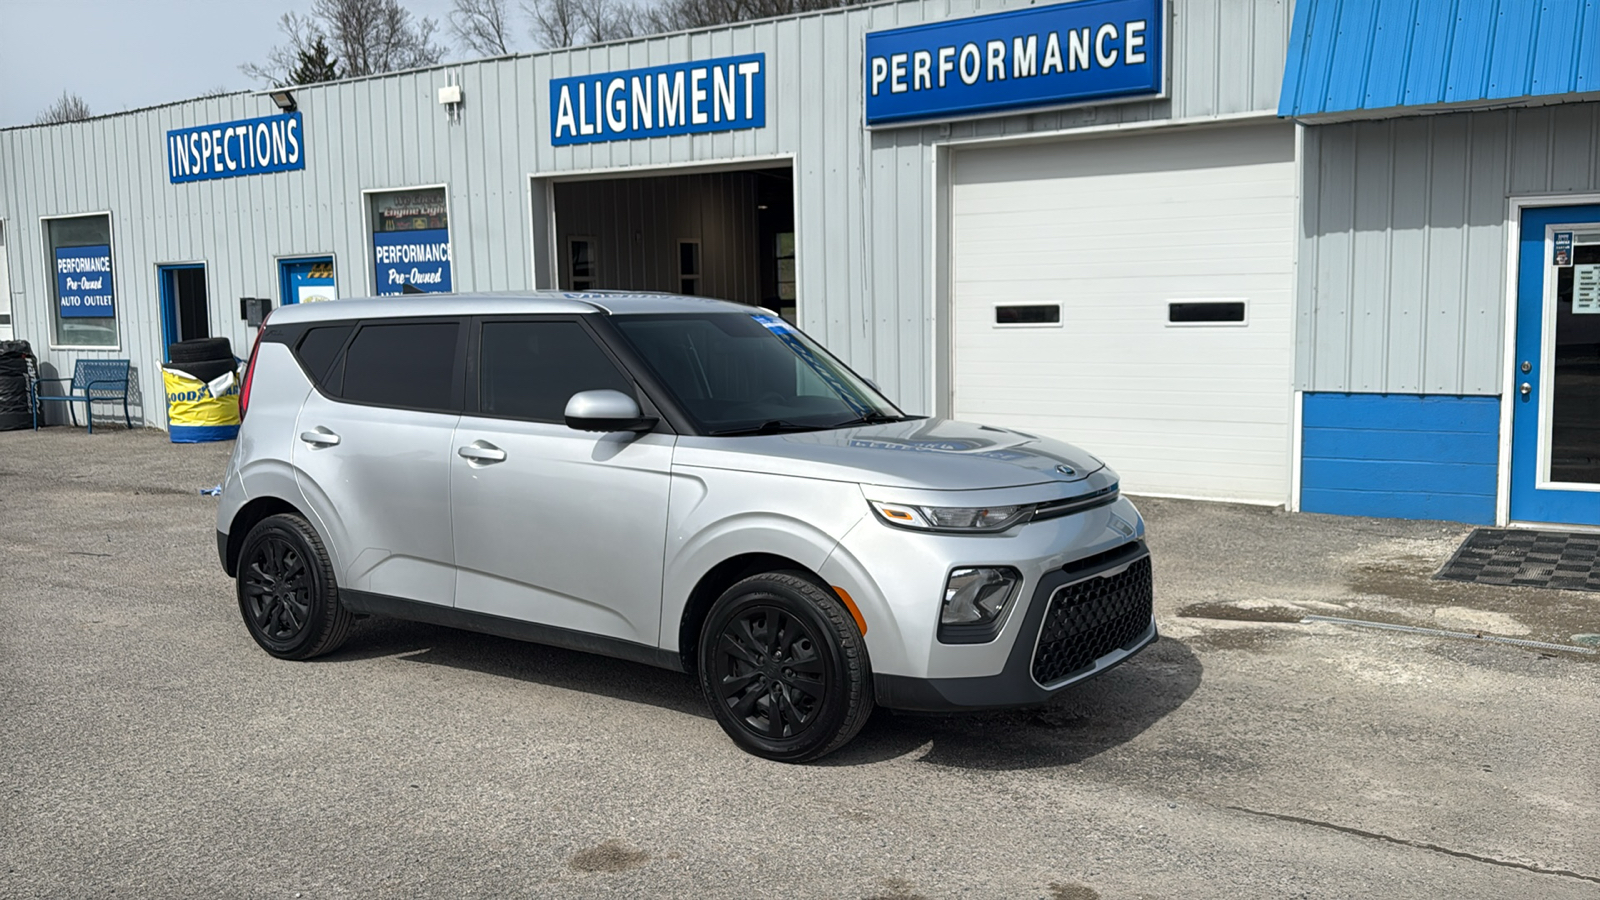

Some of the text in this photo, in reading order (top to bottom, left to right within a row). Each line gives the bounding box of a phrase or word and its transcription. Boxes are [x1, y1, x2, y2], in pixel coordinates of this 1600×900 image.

[870, 20, 1148, 96] PERFORMANCE
[555, 61, 760, 138] ALIGNMENT
[170, 118, 299, 177] INSPECTIONS
[384, 207, 419, 218] Engine
[57, 256, 111, 274] PERFORMANCE
[66, 276, 103, 291] Pre-Owned
[388, 267, 442, 285] Pre-Owned
[61, 295, 112, 307] AUTO OUTLET
